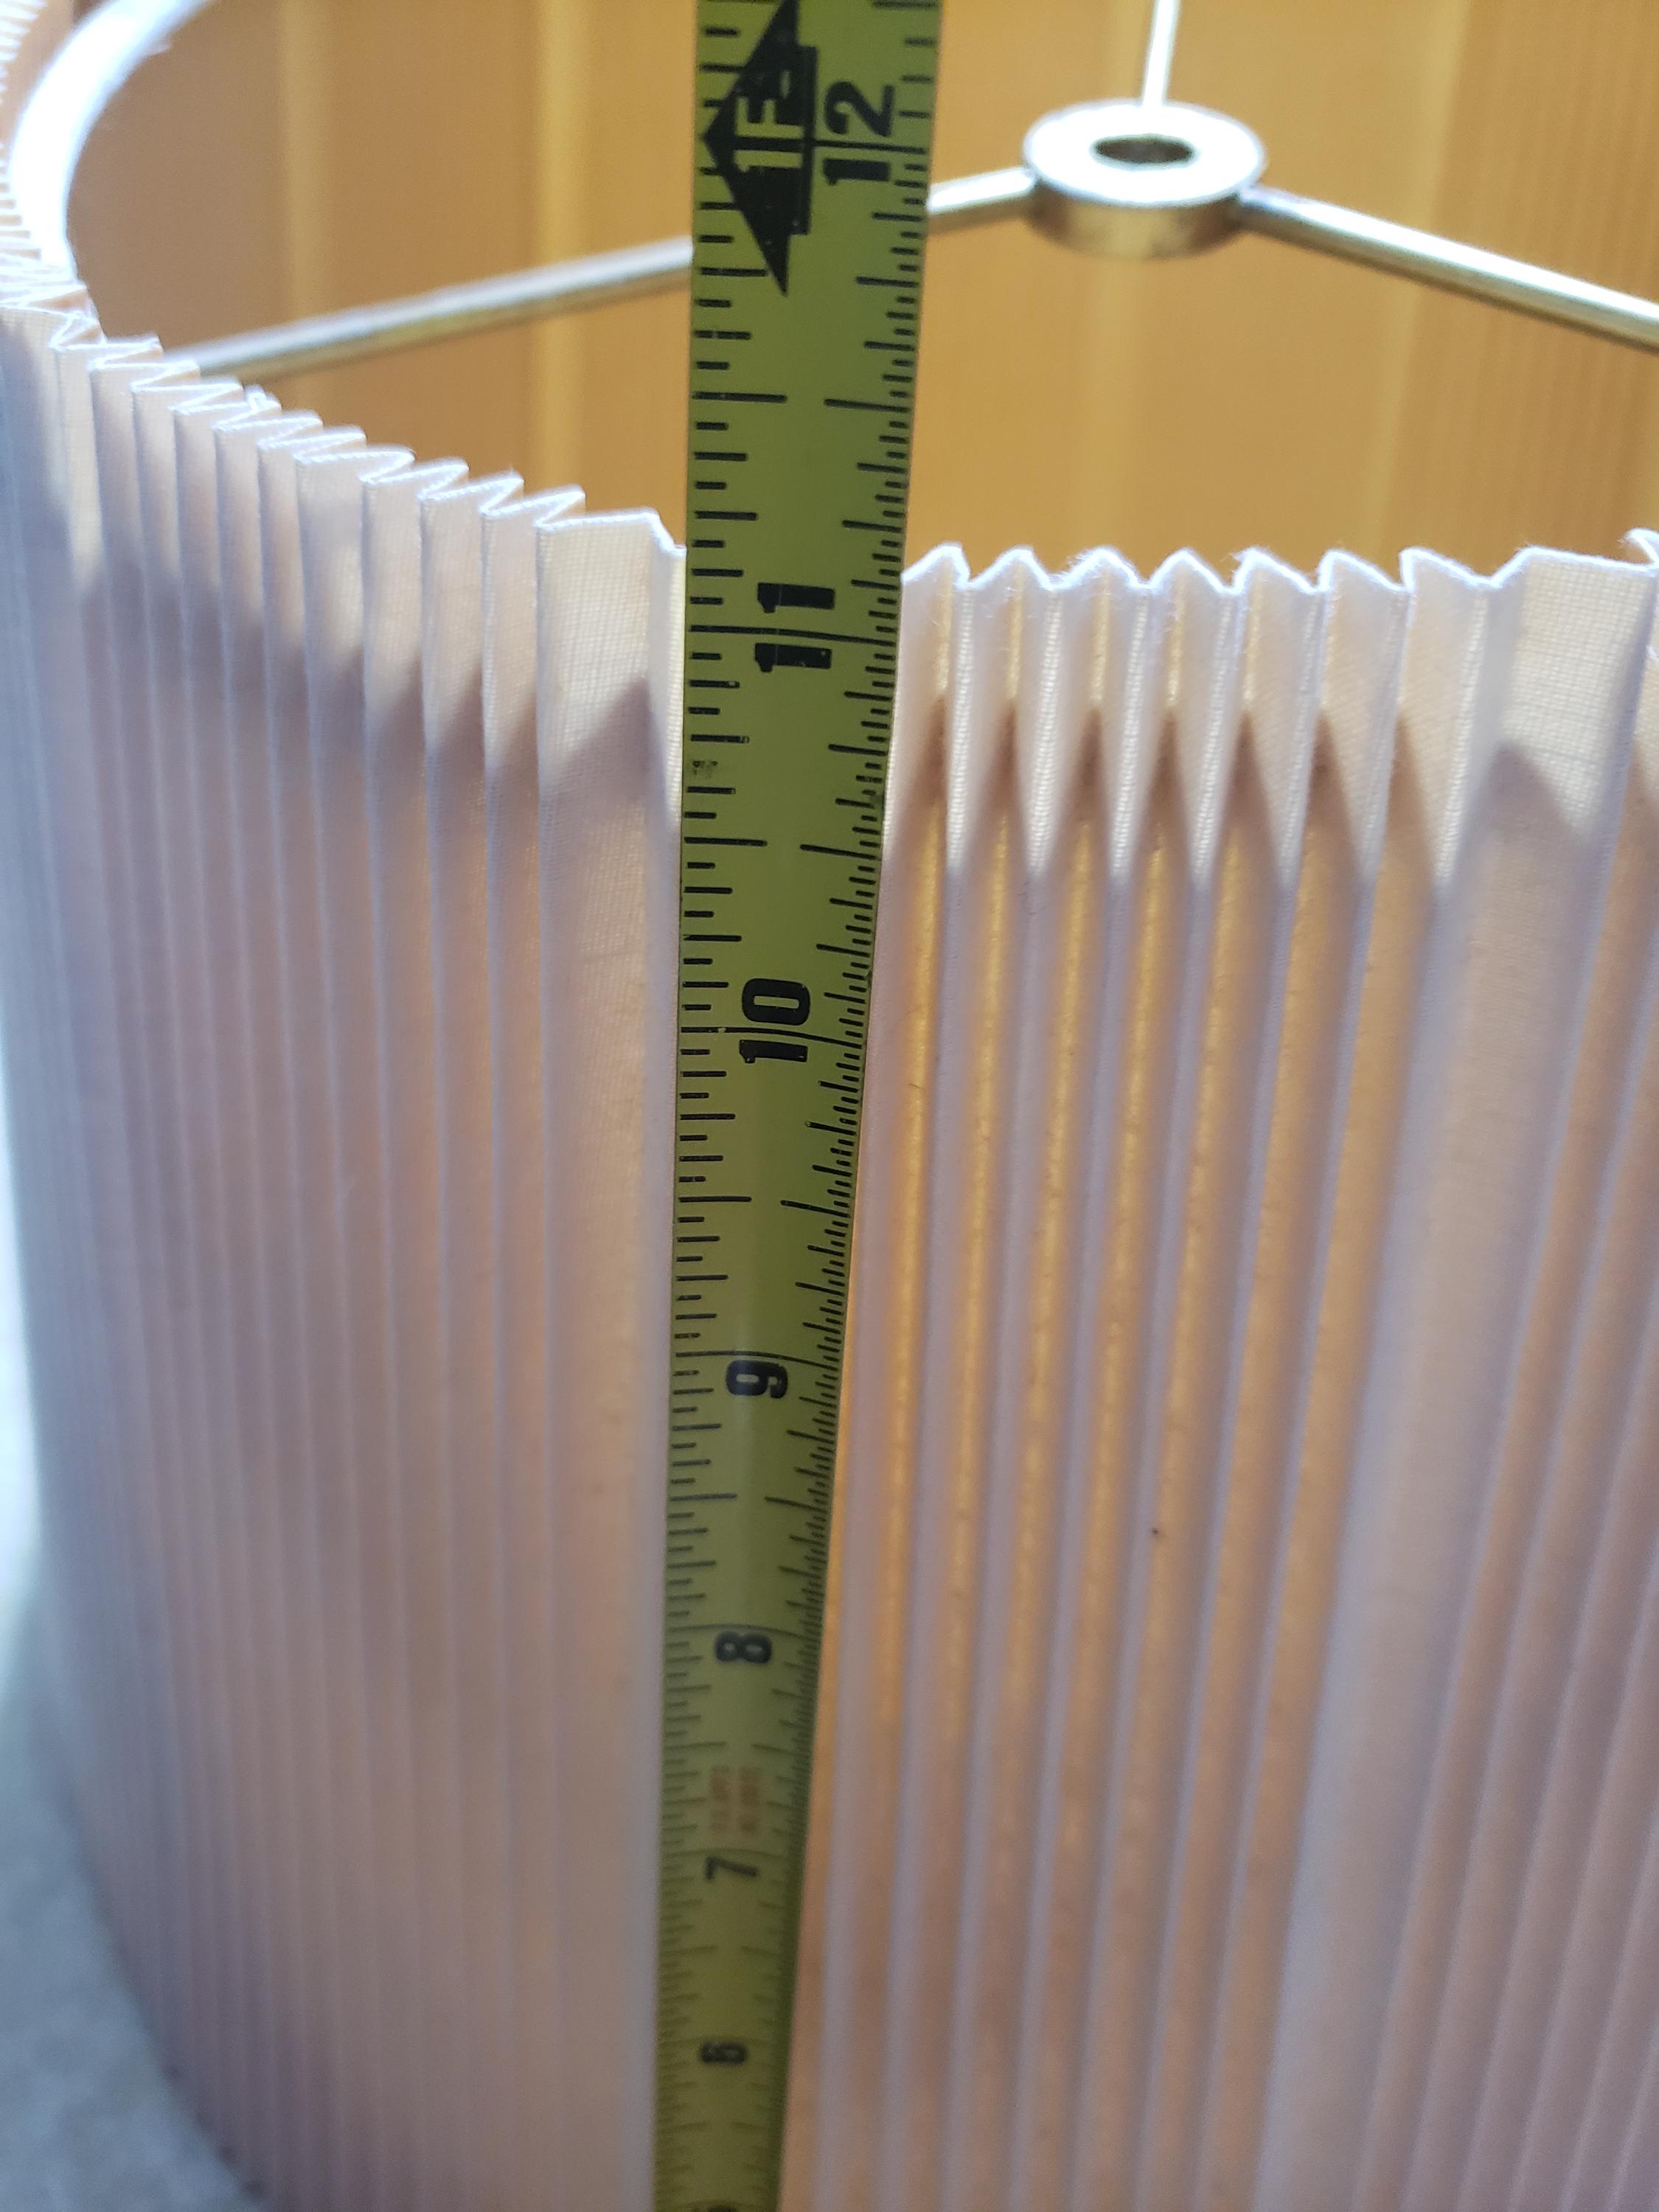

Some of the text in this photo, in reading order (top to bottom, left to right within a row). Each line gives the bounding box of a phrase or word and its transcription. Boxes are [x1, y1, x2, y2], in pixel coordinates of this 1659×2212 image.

[823, 81, 895, 186] 12
[754, 582, 835, 673] 11
[740, 978, 810, 1063] 10
[726, 1360, 788, 1399] 9
[715, 1631, 772, 1663] 8
[706, 1857, 759, 1880] 7
[700, 2040, 748, 2064] 6
